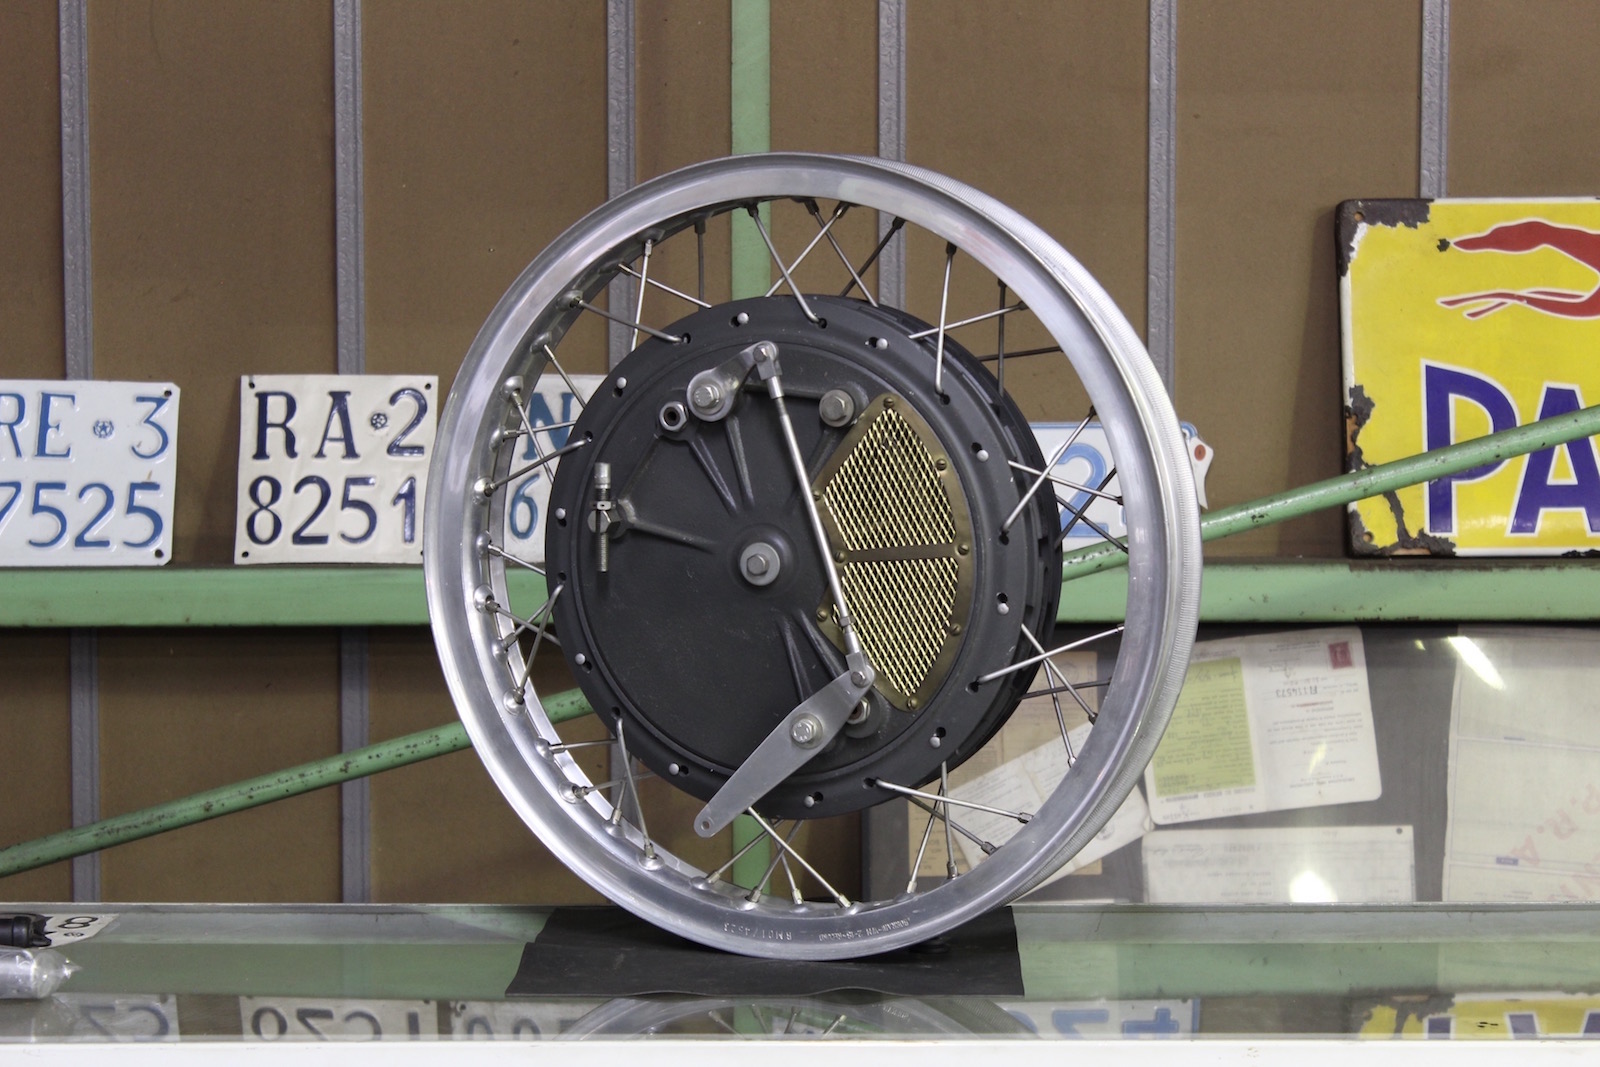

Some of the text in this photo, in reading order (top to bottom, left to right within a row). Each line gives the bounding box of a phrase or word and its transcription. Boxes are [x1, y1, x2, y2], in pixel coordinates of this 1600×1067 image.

[131, 396, 169, 459] 3
[252, 387, 428, 460] RA 2
[1421, 358, 1600, 536] PA
[246, 475, 416, 545] 8251
